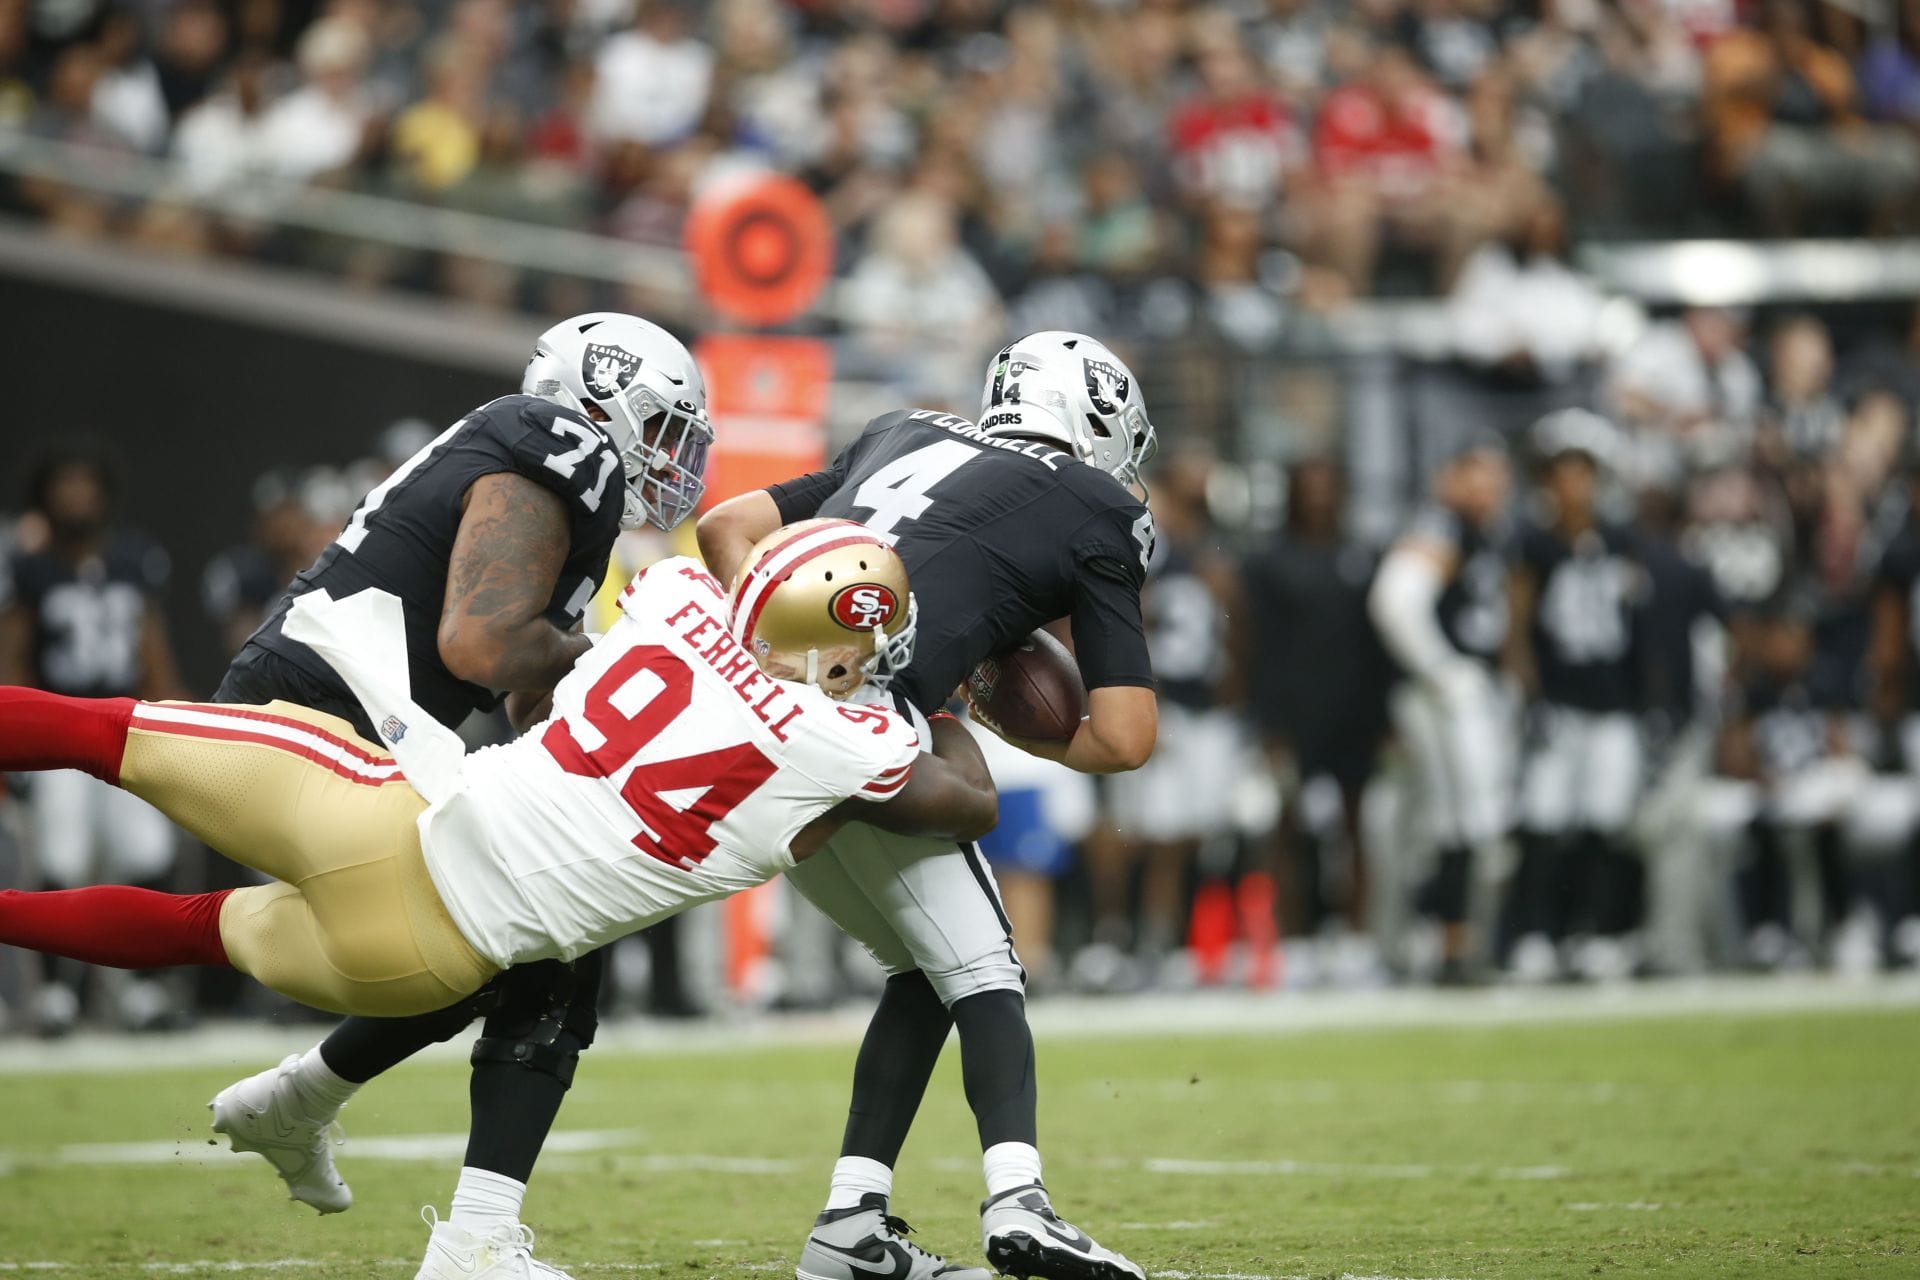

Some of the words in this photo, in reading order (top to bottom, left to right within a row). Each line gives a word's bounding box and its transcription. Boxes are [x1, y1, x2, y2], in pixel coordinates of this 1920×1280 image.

[591, 344, 638, 364] RAIDERS
[1087, 359, 1127, 382] RAIDERS
[1004, 382, 1021, 405] 4
[543, 416, 619, 513] 71
[852, 438, 983, 548] 4
[851, 588, 890, 627] SF
[664, 600, 804, 743] FERRELL
[540, 644, 779, 872] 94
